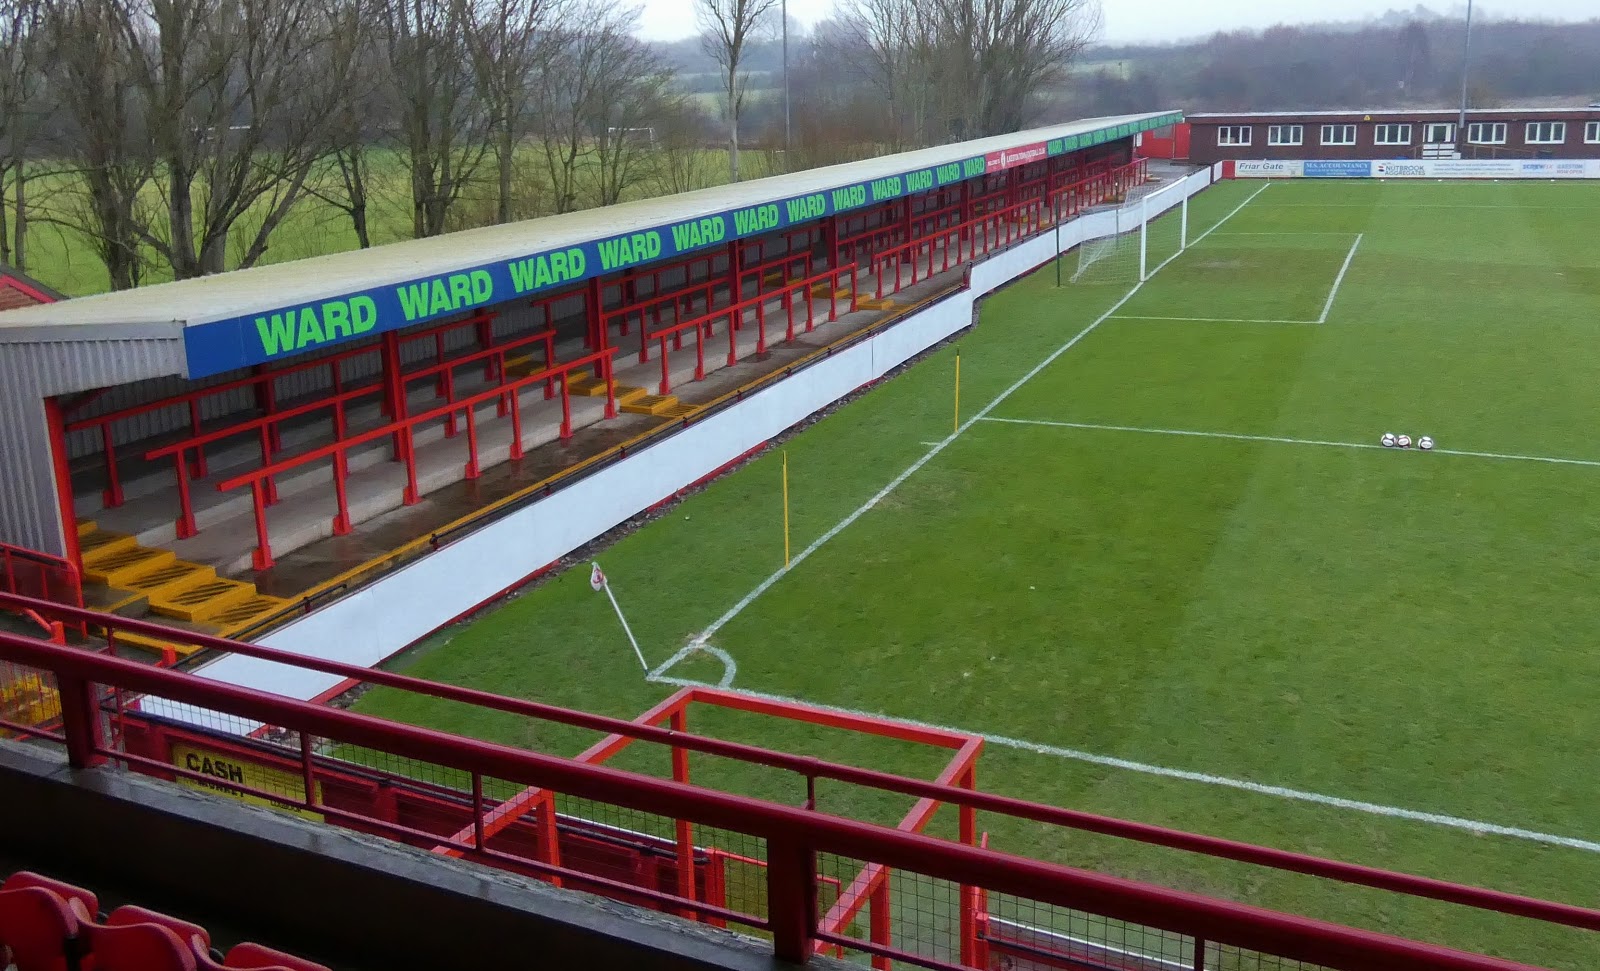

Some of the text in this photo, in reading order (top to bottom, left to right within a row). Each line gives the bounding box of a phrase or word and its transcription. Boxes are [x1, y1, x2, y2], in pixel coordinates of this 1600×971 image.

[1239, 162, 1260, 170] Friar
[1263, 162, 1284, 170] Gate
[255, 156, 985, 356] WARD WARD WARD WARD WARD WARD WARD WARD WARD WARD WARD WARD
[186, 752, 243, 784] CASH
